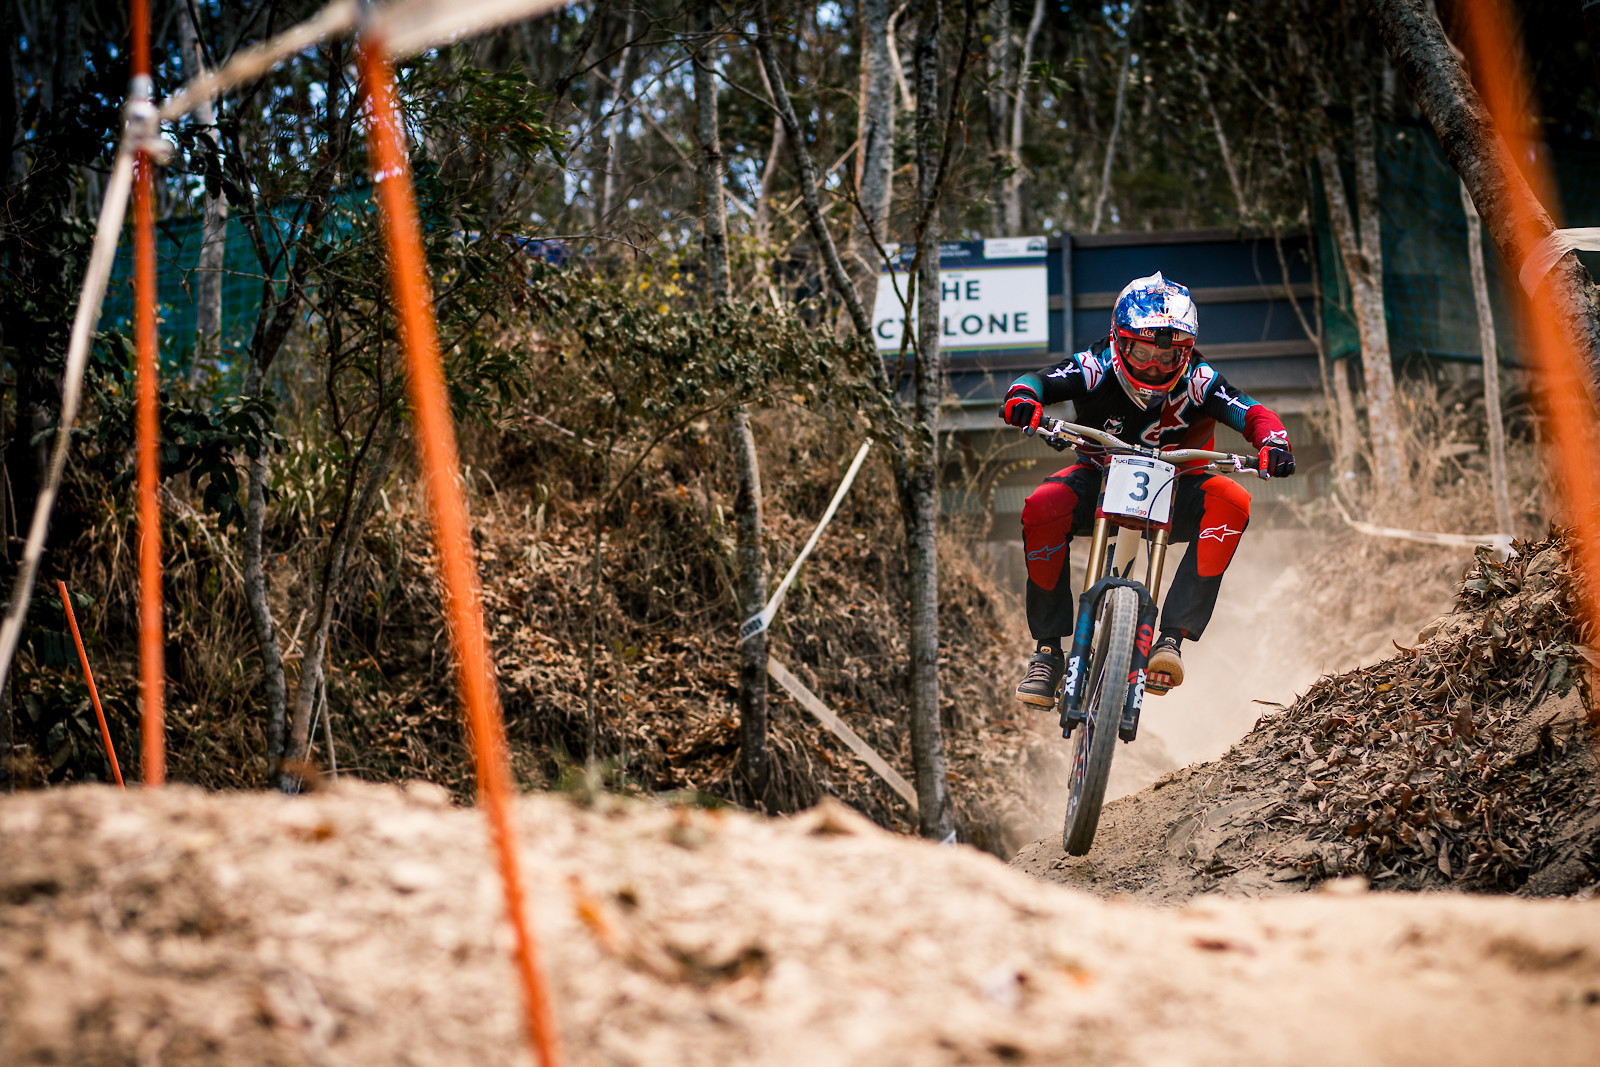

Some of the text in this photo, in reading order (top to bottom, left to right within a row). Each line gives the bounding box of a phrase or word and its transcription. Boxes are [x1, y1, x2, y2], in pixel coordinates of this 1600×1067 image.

[941, 280, 981, 301] HE
[1213, 385, 1251, 410] YT
[1129, 471, 1150, 502] 3
[1136, 624, 1153, 658] 40
[1064, 655, 1081, 697] FOX
[1133, 668, 1147, 709] FOX
